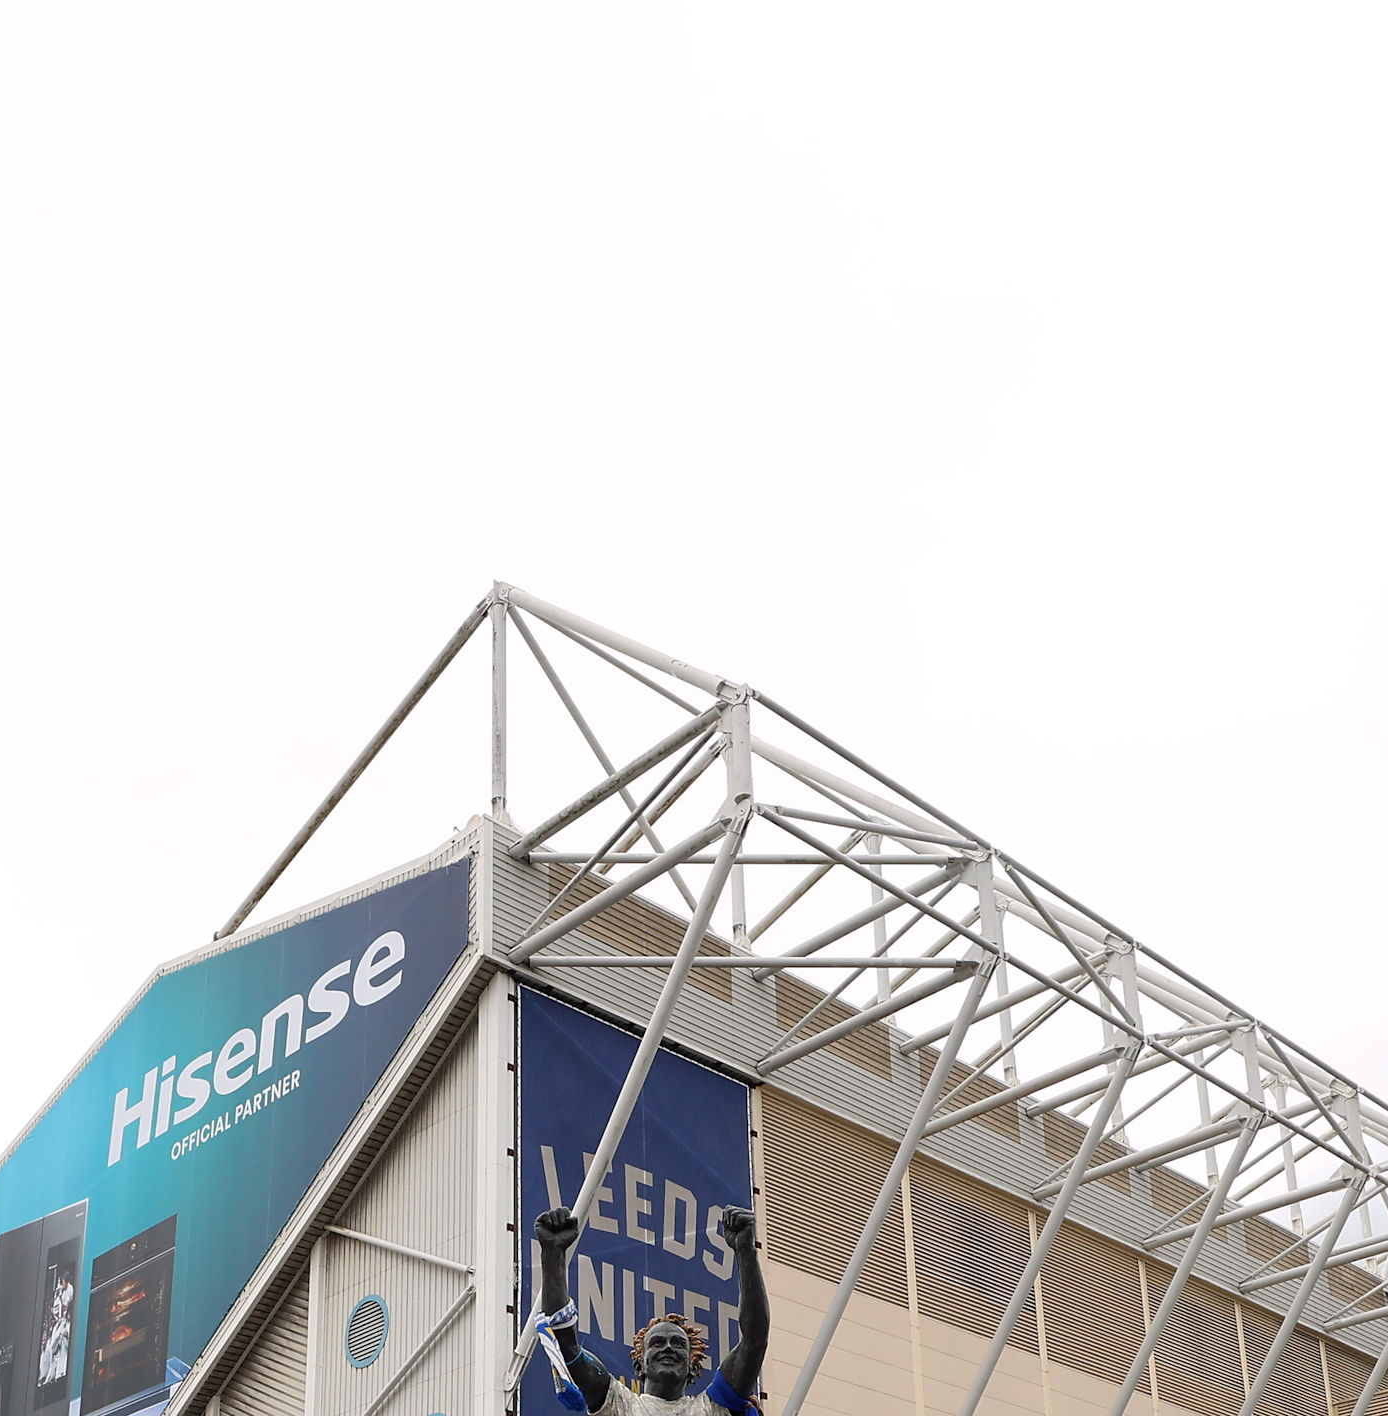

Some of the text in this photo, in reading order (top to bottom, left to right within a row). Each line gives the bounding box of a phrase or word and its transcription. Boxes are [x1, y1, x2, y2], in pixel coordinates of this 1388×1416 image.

[107, 930, 405, 1167] Hisense
[171, 1069, 301, 1160] OFFICIAL PARTNER
